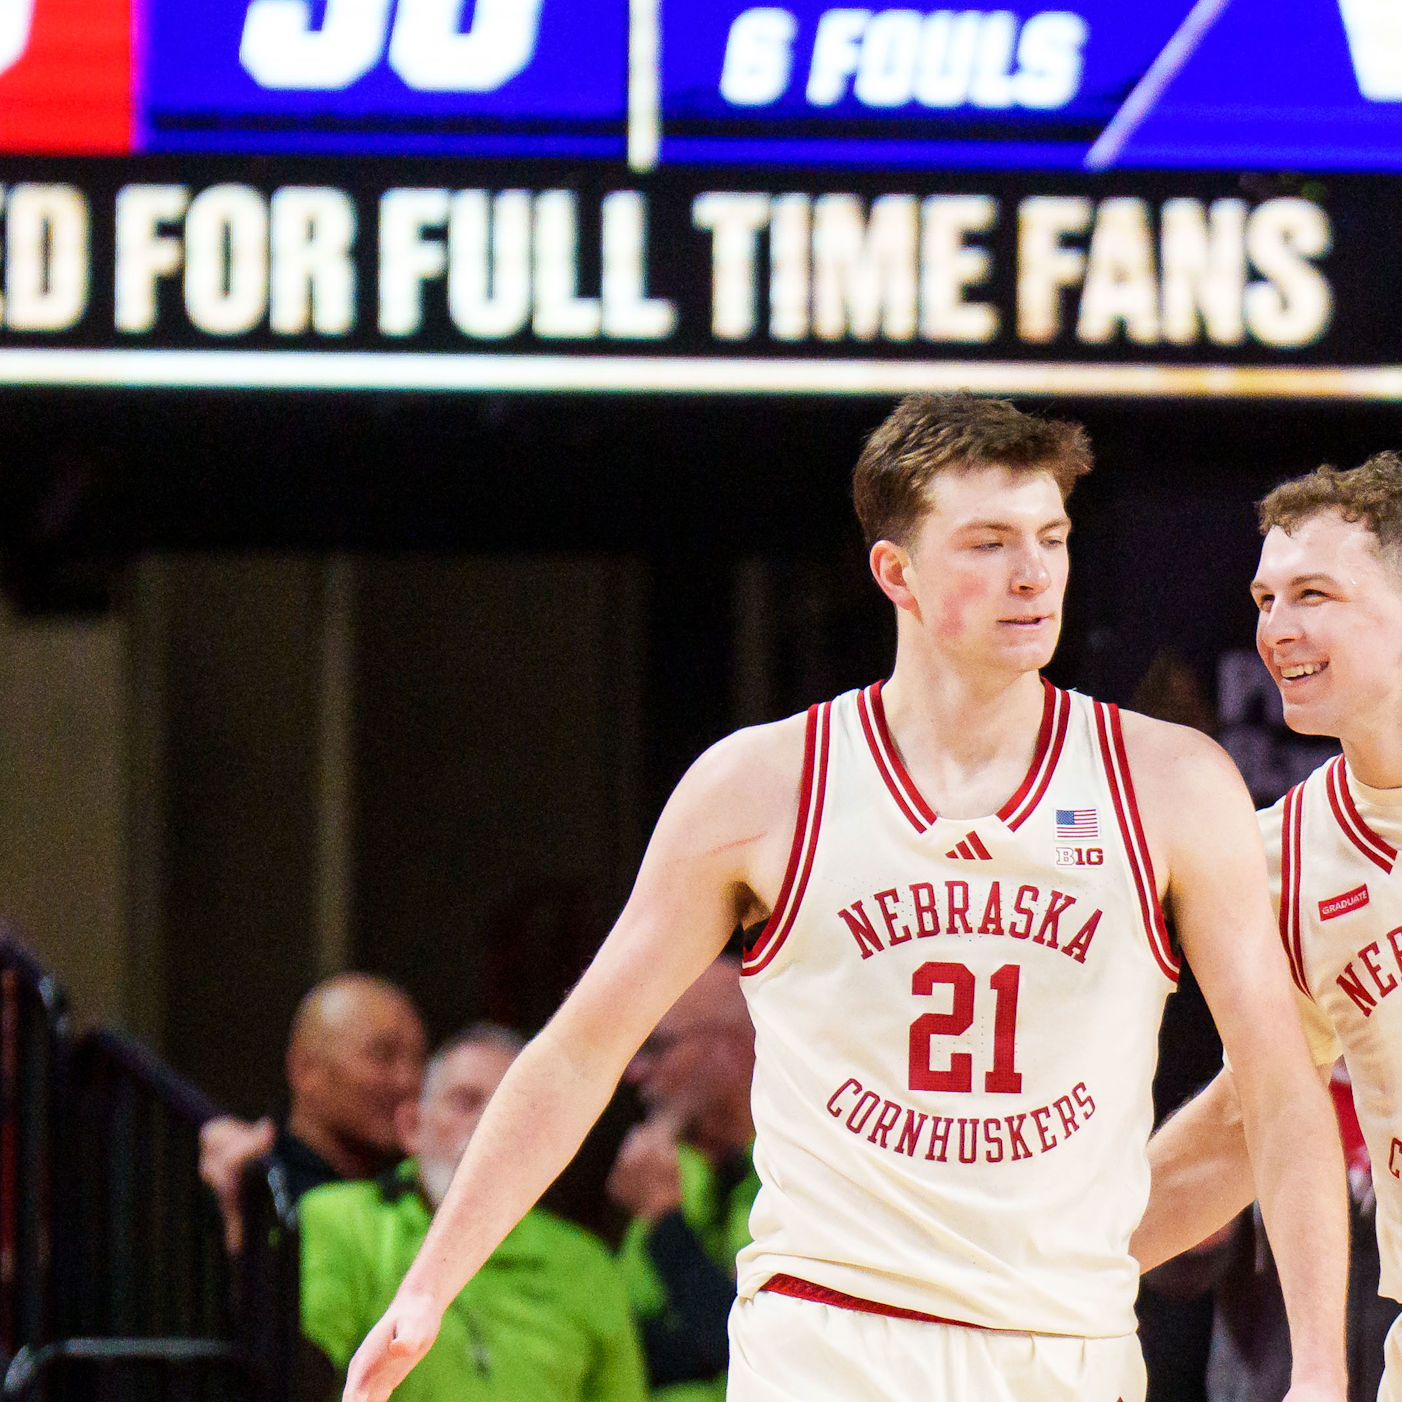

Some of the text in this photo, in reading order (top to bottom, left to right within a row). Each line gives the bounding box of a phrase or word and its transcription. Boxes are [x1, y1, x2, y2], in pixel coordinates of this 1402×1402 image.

[719, 6, 1089, 110] 6 FOULS
[0, 183, 1333, 349] D FOR FULL TIME FANS
[837, 879, 1104, 965] NEBRASKA
[1320, 889, 1368, 915] GRADUATE
[908, 961, 1023, 1094] 21
[826, 1077, 1097, 1165] CORNHUSKERS
